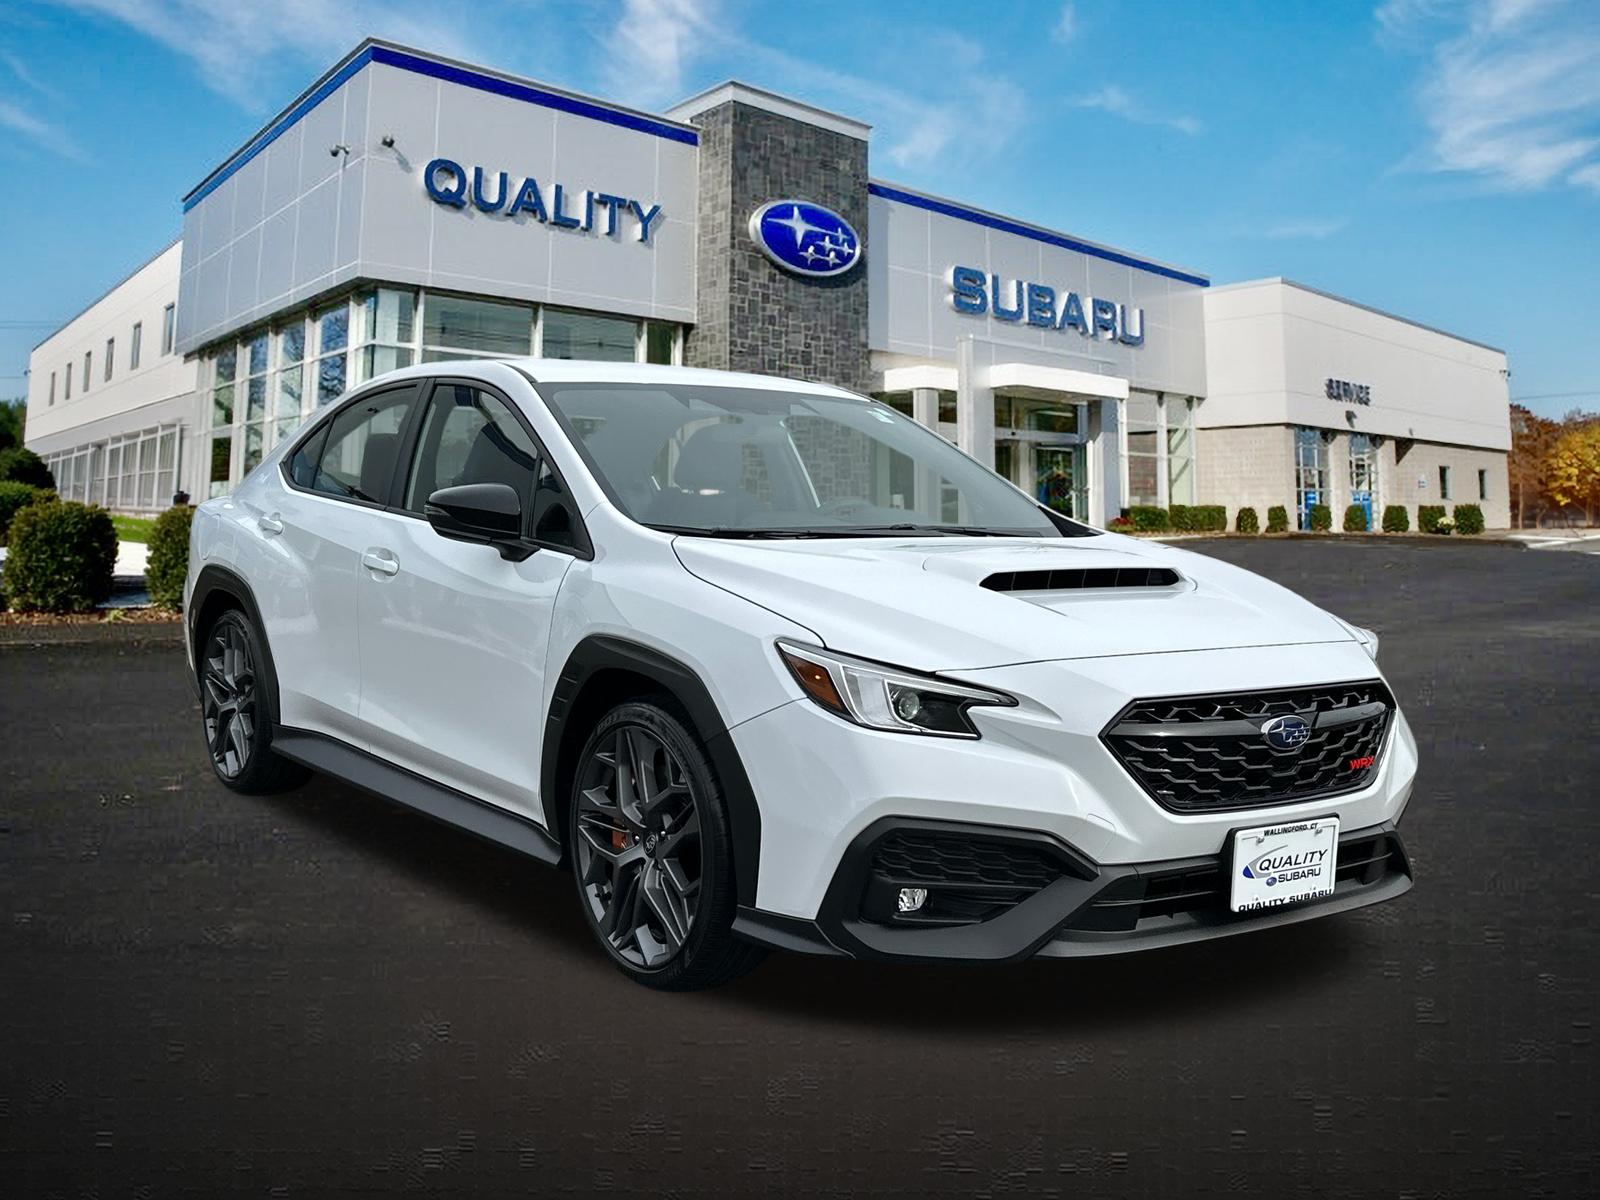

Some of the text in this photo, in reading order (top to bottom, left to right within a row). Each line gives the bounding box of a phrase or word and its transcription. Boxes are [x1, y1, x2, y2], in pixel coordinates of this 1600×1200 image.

[424, 158, 662, 243] QUALITY
[948, 265, 1145, 347] SUBARU
[1325, 378, 1371, 406] SERVICE
[1350, 755, 1375, 770] WRX
[1310, 822, 1319, 830] CT
[1259, 849, 1328, 872] QUALITY
[1278, 867, 1321, 883] SUBARU
[1238, 888, 1332, 911] QUALITY SUBARU
